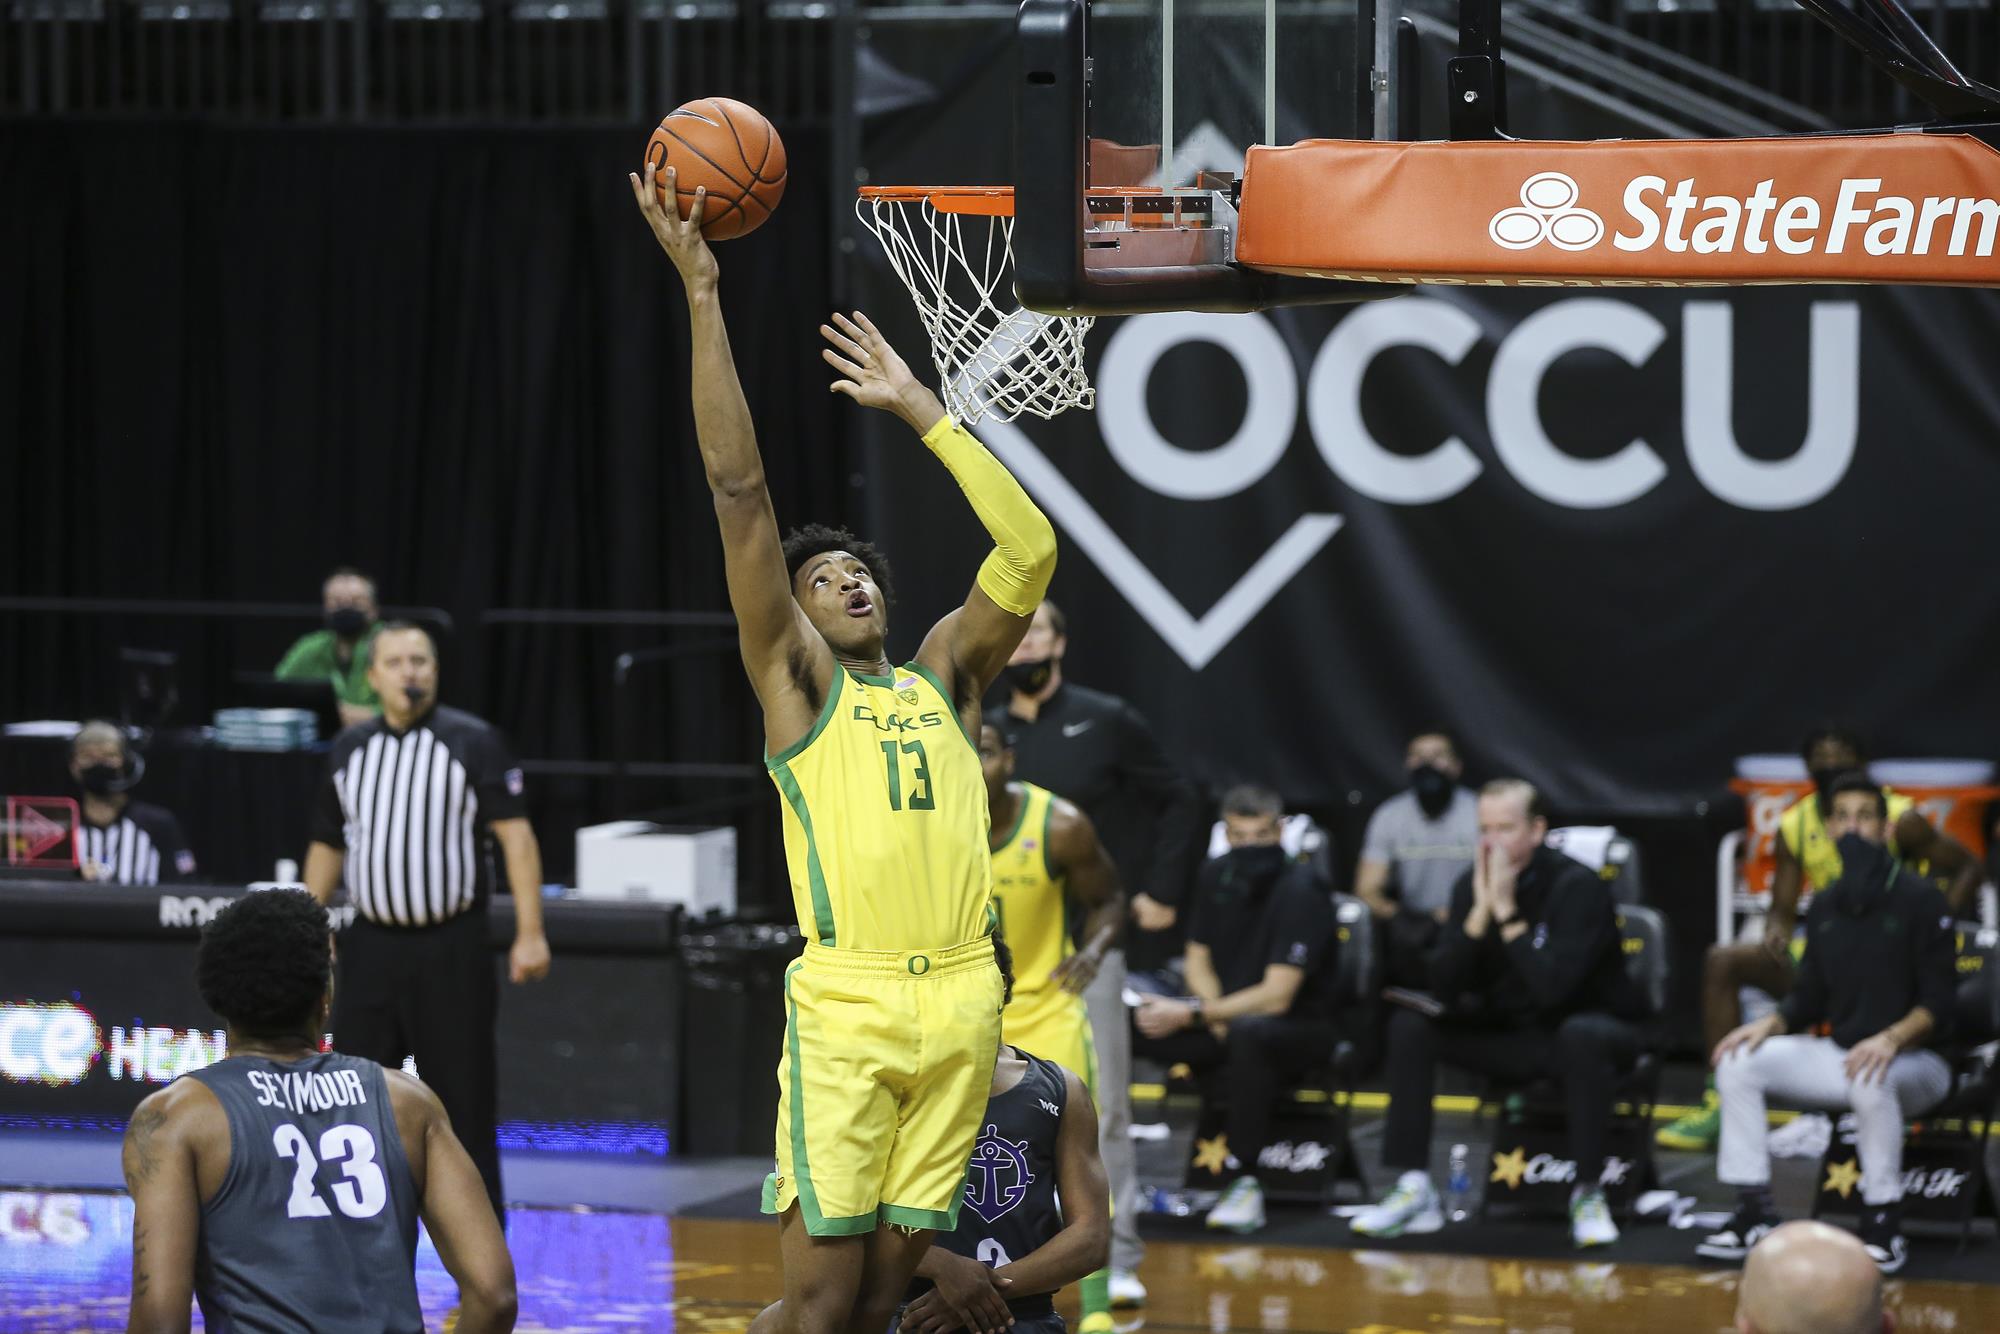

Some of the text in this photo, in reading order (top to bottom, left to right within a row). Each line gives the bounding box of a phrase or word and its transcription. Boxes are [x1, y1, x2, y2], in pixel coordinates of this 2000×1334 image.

[1096, 299, 1861, 511] OCCU
[880, 739, 936, 811] 13
[247, 1069, 367, 1114] SEYMOUR
[272, 1123, 387, 1219] 23
